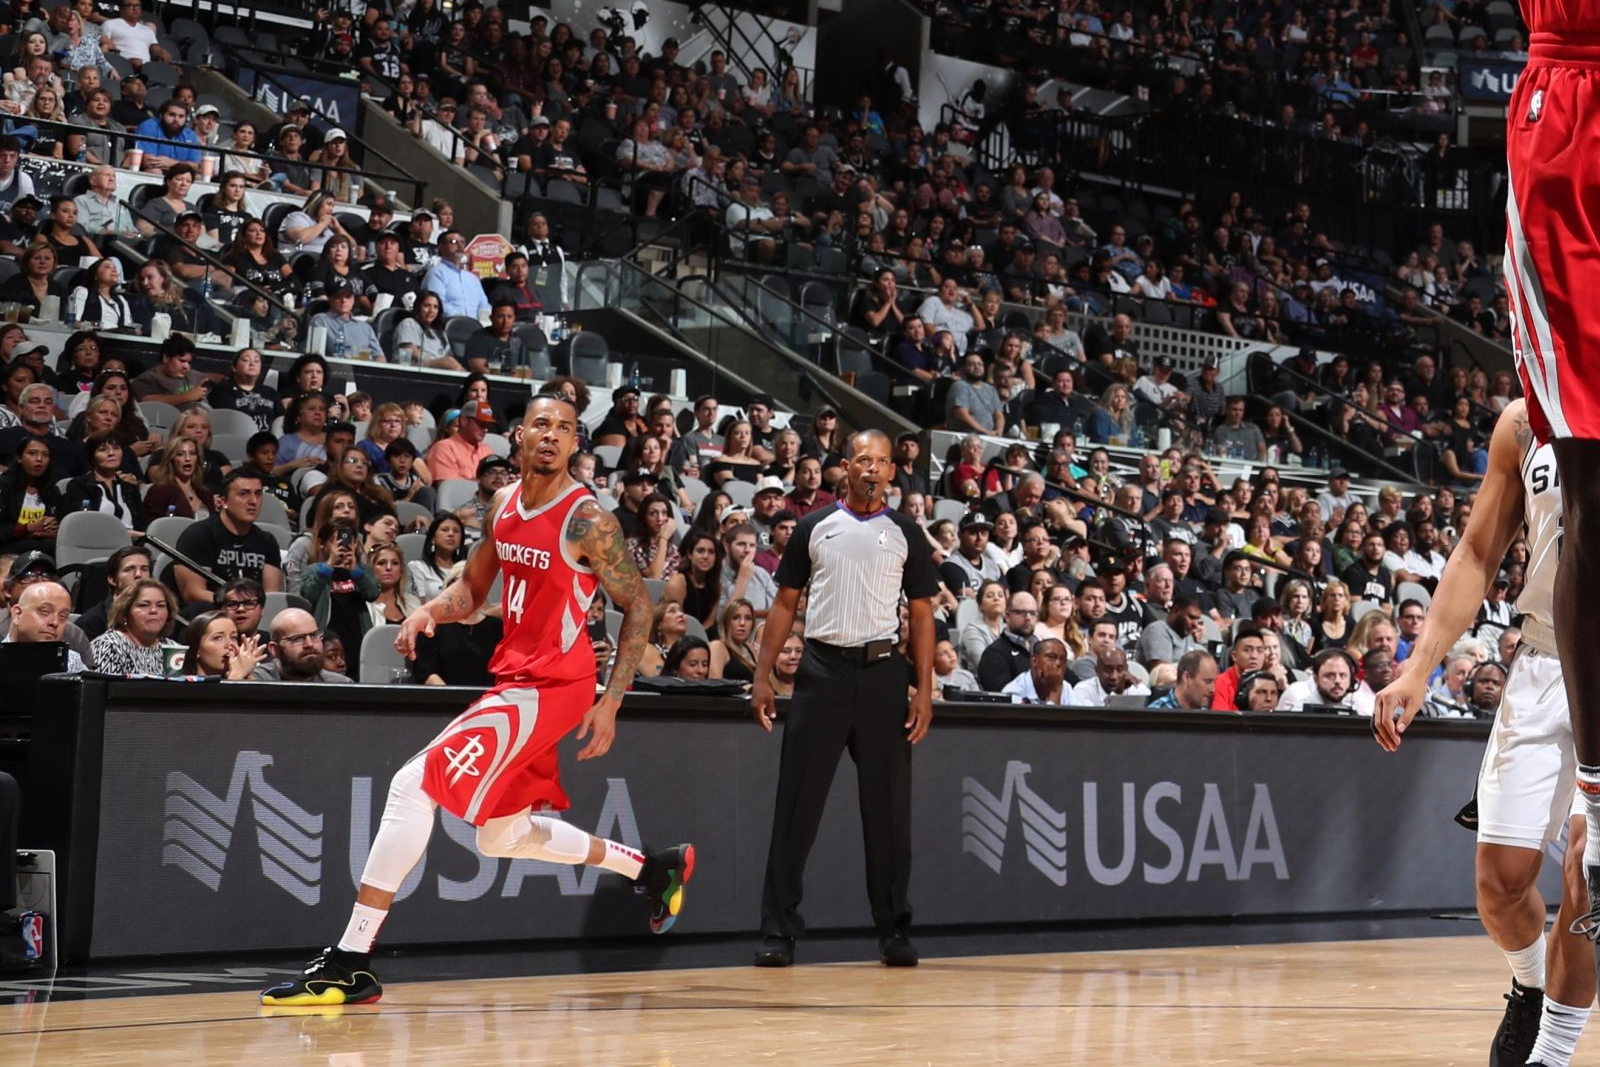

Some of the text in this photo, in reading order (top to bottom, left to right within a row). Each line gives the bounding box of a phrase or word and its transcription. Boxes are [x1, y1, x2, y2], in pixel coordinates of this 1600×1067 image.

[217, 548, 266, 570] SPURS
[495, 539, 550, 570] ROCKETS
[507, 574, 527, 624] 14
[1083, 781, 1290, 886] USAA
